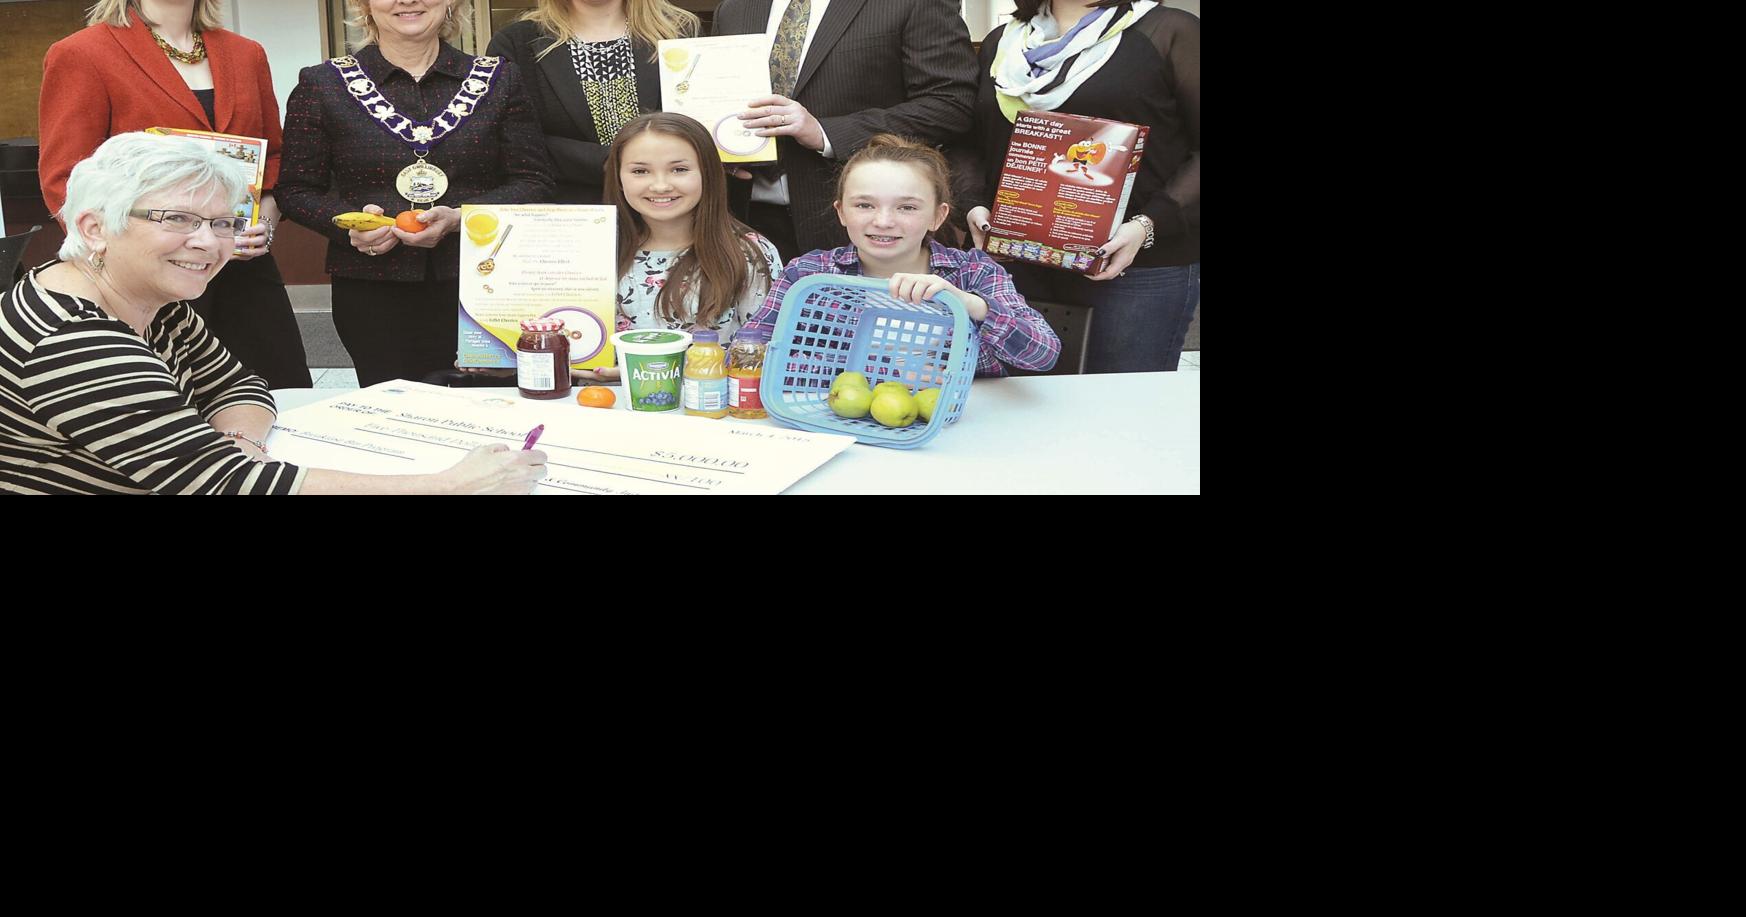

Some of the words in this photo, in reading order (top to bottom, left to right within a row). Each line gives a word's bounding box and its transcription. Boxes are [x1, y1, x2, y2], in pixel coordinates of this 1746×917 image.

[1023, 116, 1049, 126] GREAT
[1050, 120, 1064, 129] day
[1051, 127, 1071, 135] great
[1023, 142, 1047, 151] BONNE
[1015, 157, 1028, 165] bon
[1028, 160, 1048, 168] PETIT
[633, 366, 680, 381] ACTIVIA
[441, 418, 479, 430] Public
